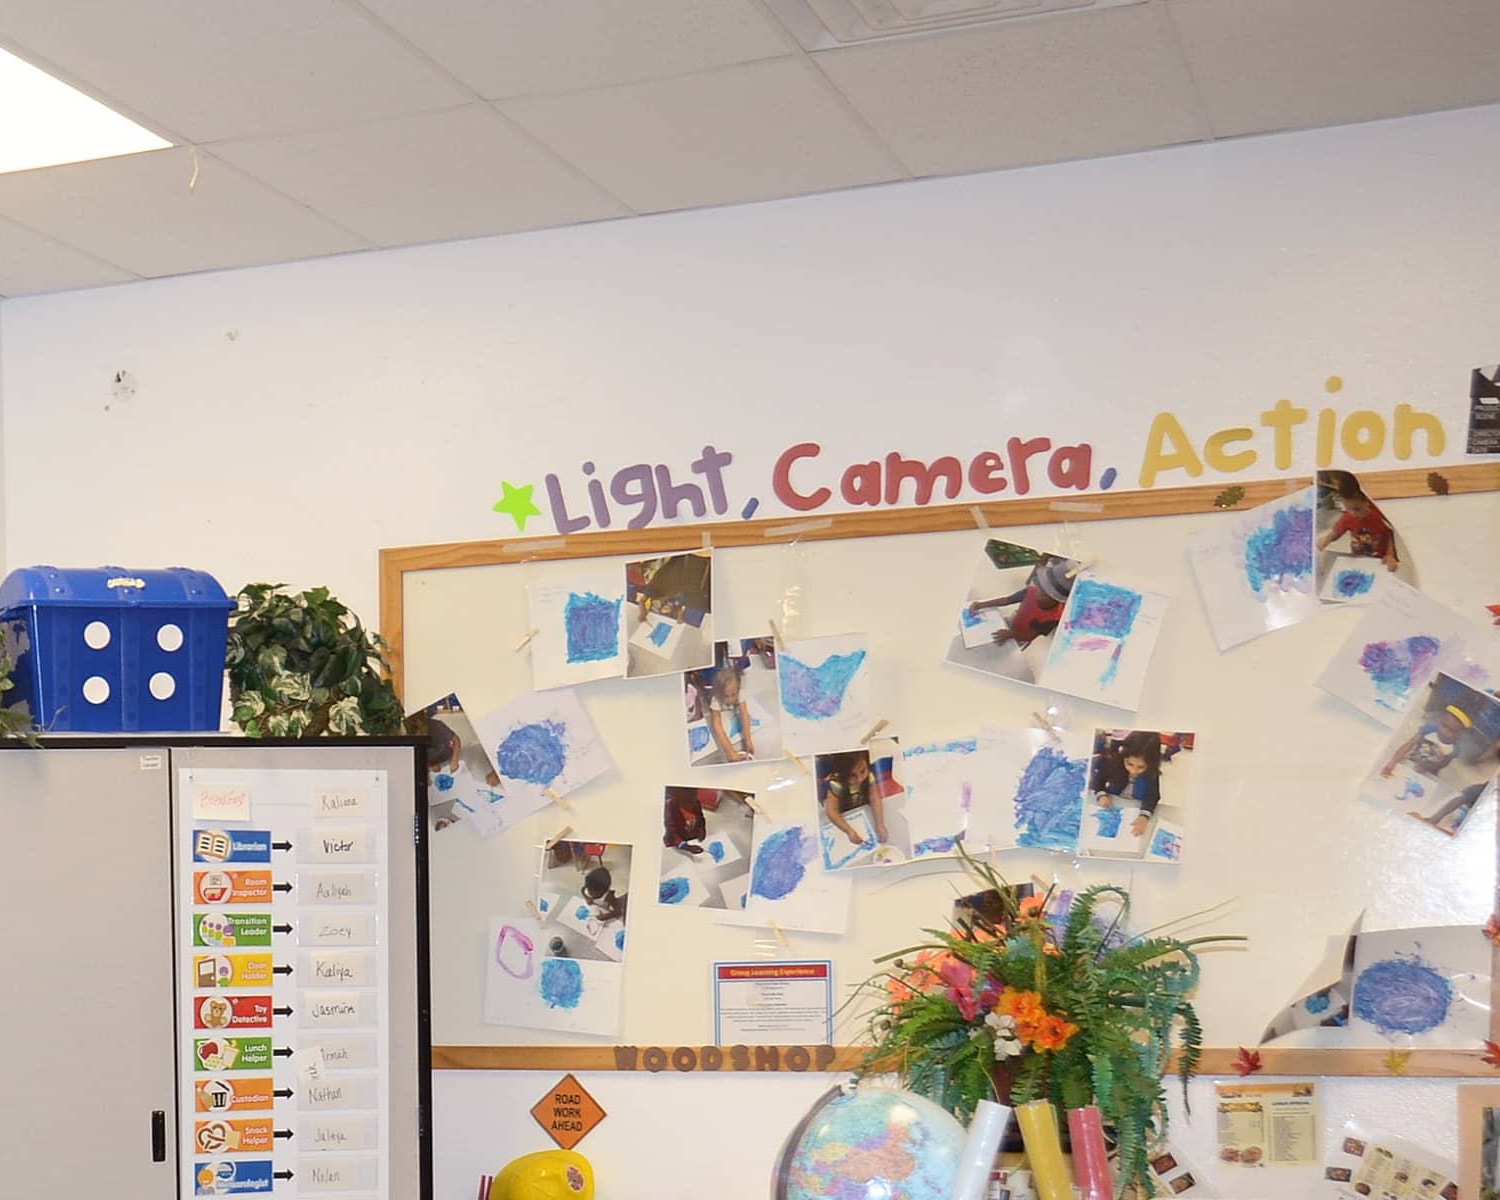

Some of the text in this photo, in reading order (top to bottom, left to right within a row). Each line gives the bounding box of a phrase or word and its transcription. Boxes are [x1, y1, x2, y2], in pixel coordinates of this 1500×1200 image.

[544, 376, 1446, 534] Light, Camera, Action
[323, 838, 354, 854] Victor
[245, 878, 268, 886] Room
[227, 917, 268, 925] Transition
[240, 927, 268, 936] Leader
[254, 1004, 268, 1015] Toy
[231, 1015, 268, 1024] Detective
[244, 1044, 268, 1052] Lunch
[241, 1054, 268, 1064] Helper
[231, 1095, 269, 1103] Custodian
[555, 1094, 581, 1105] ROAD
[553, 1107, 582, 1118] WORK
[551, 1120, 583, 1131] AHEAD
[244, 1126, 268, 1135] Snack
[242, 1136, 269, 1145] Helper
